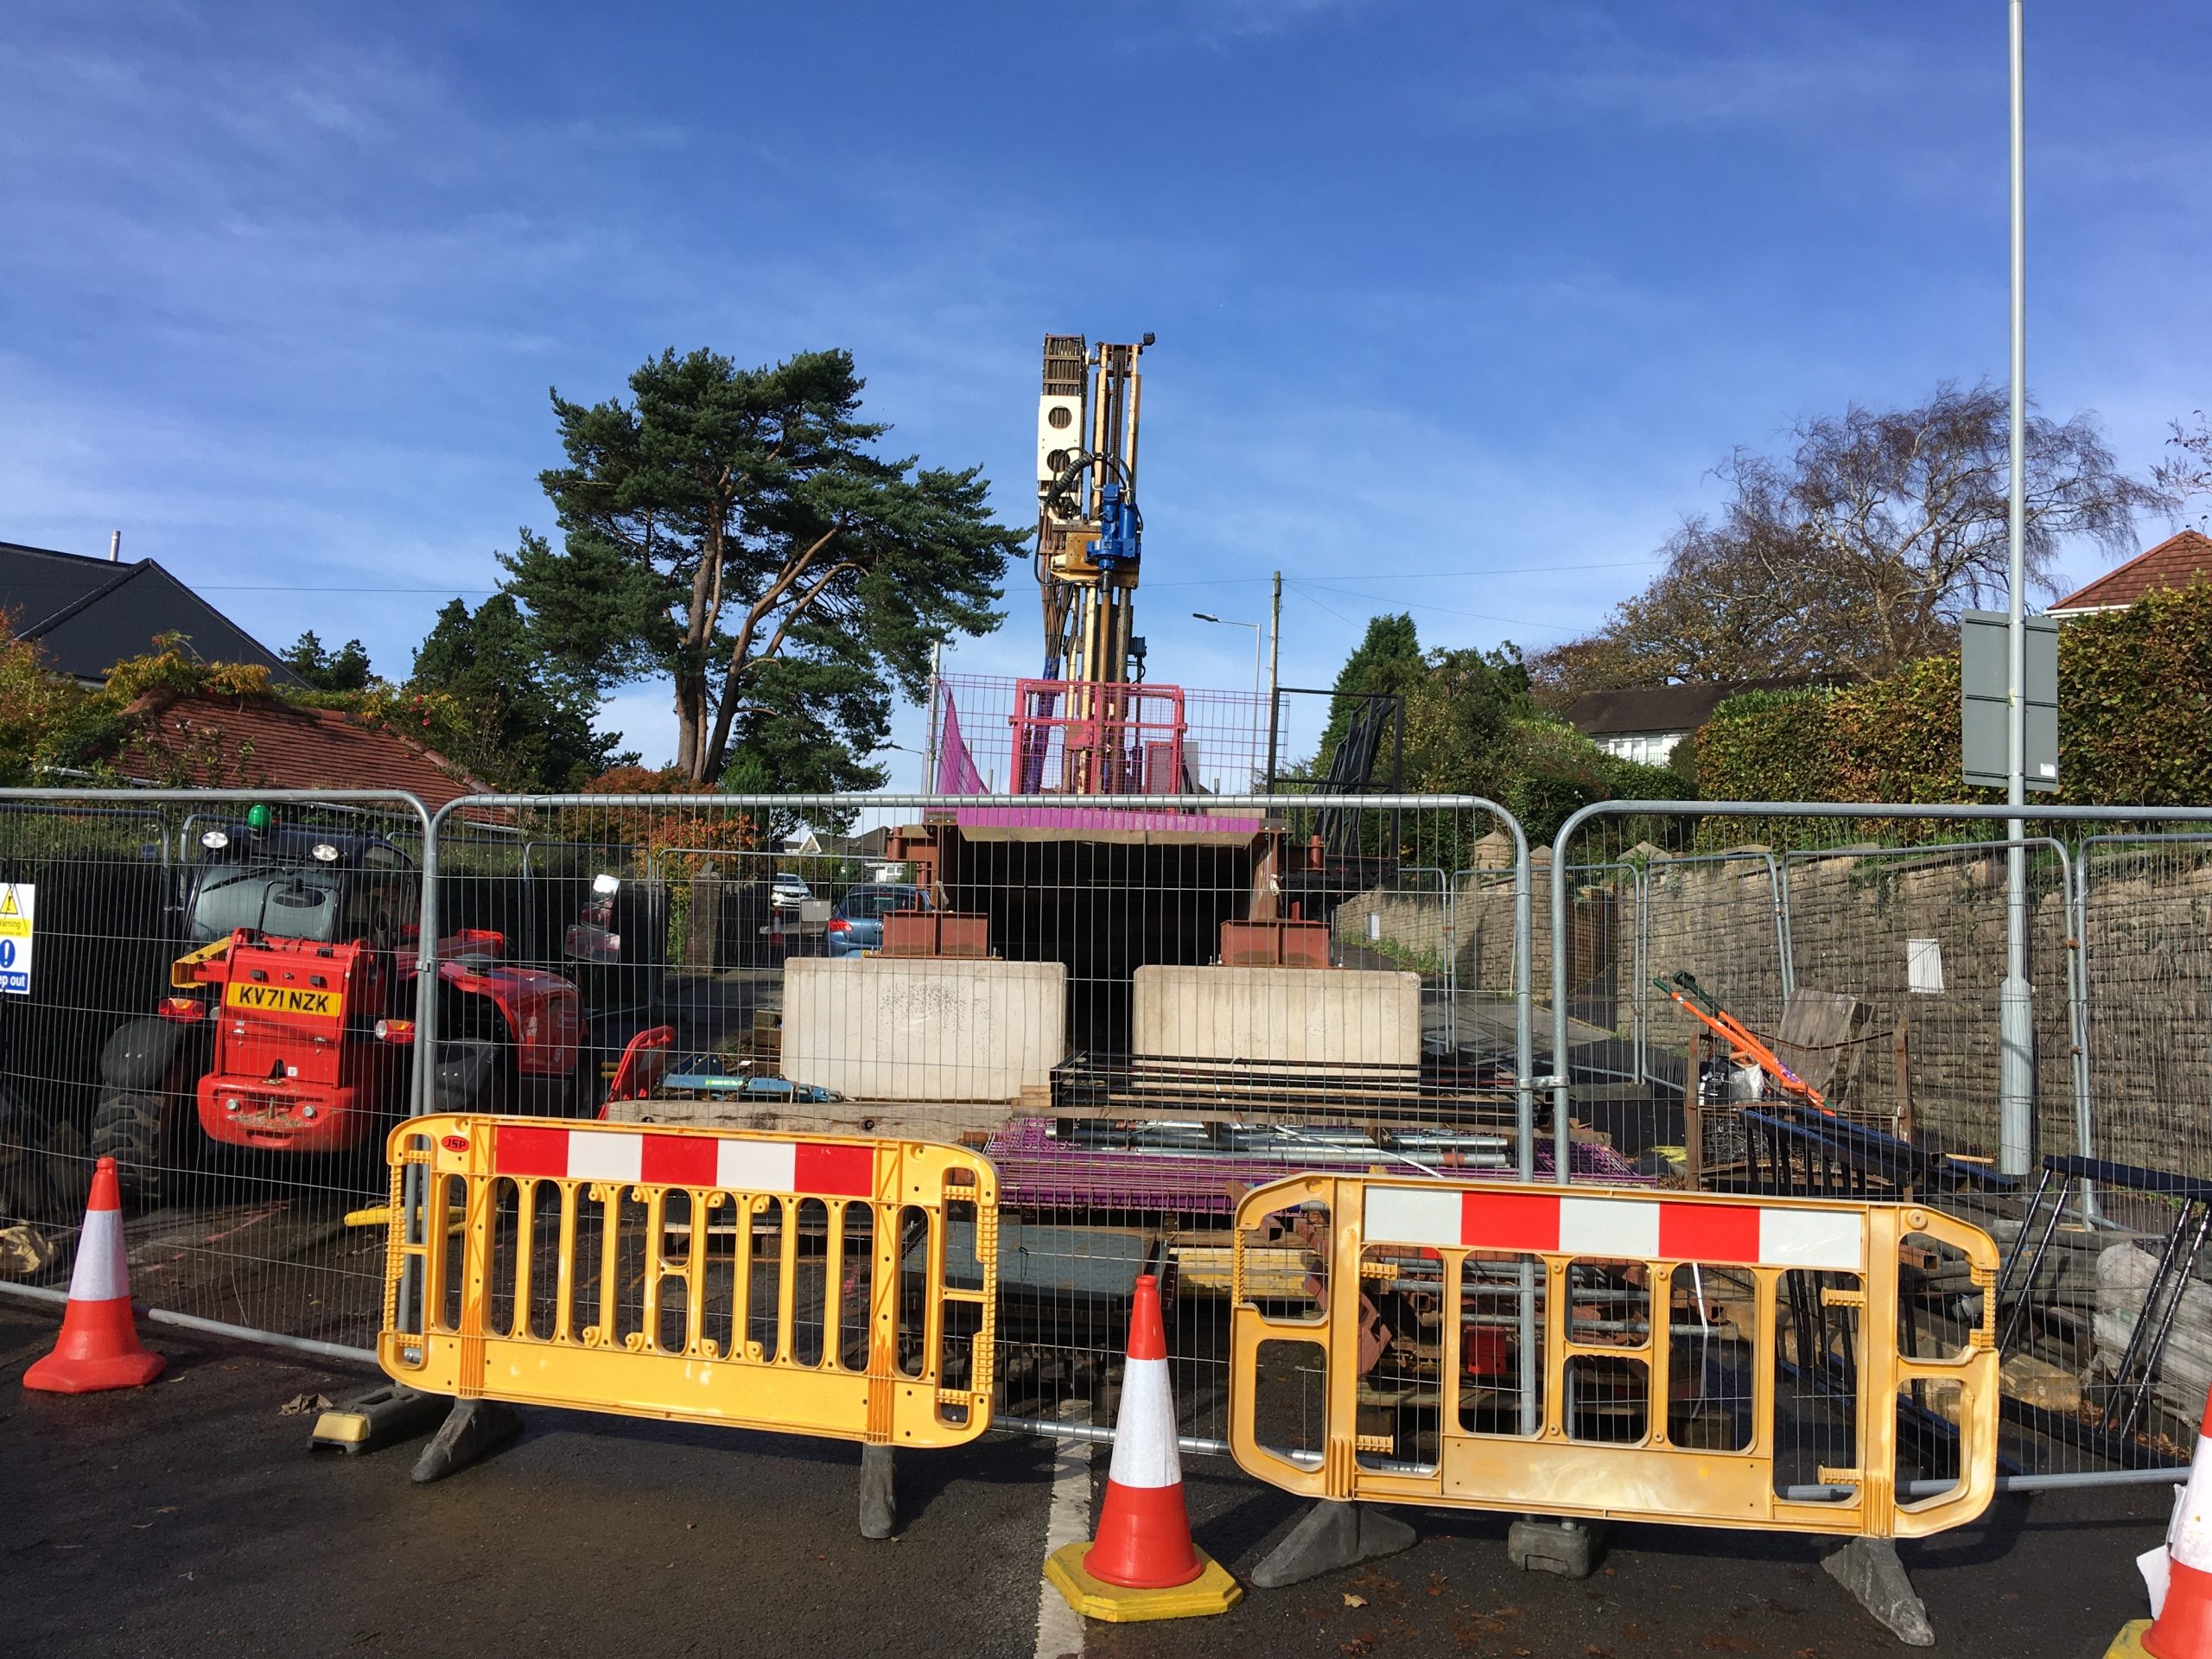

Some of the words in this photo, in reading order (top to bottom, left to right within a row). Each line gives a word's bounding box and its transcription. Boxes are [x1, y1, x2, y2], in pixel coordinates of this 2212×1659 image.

[10, 975, 26, 988] out
[239, 985, 284, 1008] KV71
[289, 990, 329, 1013] NZK
[445, 1138, 467, 1149] JSP
